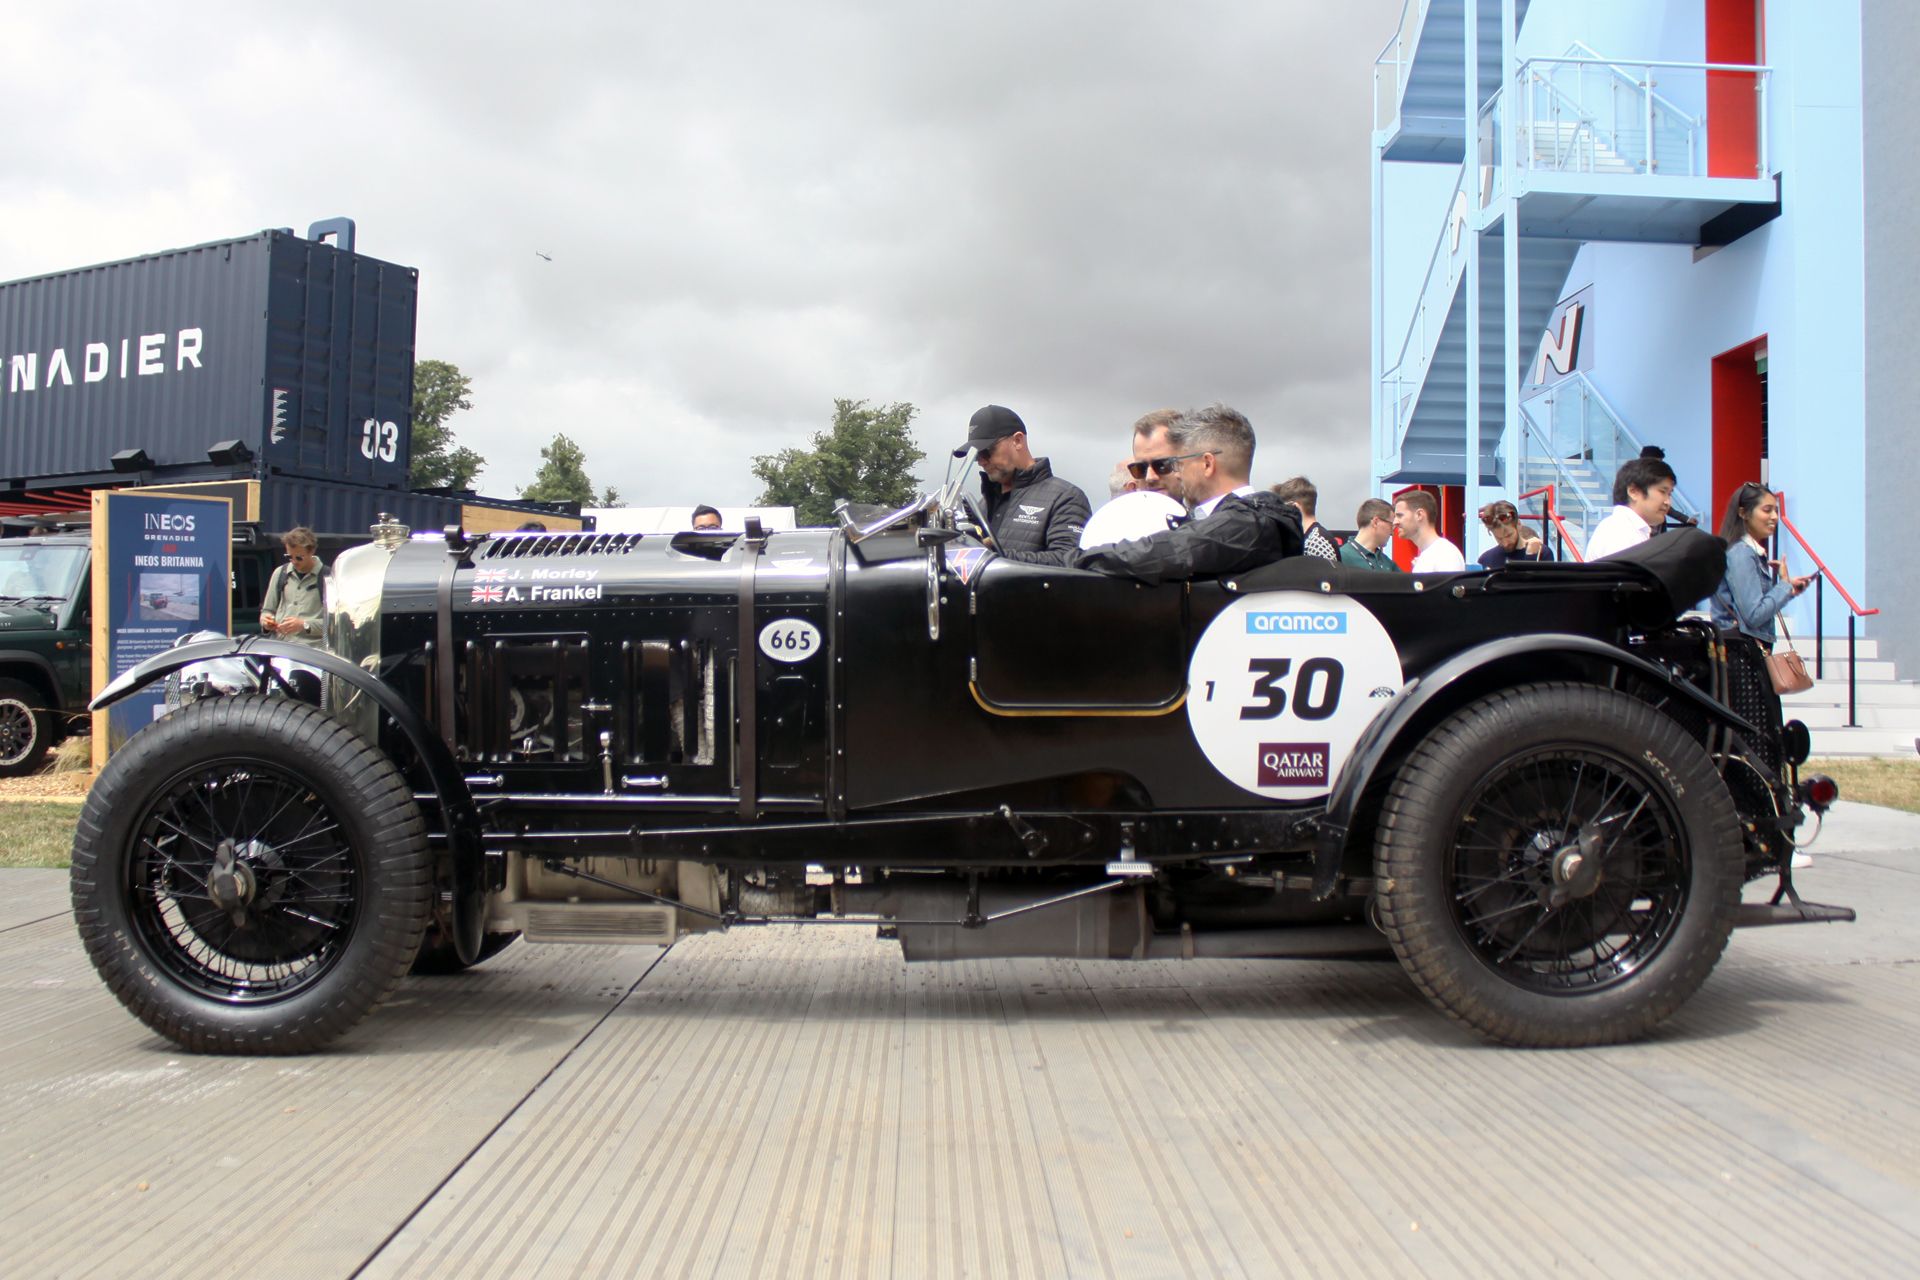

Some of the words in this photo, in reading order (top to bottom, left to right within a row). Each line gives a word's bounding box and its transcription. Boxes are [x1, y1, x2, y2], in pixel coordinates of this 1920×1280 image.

[0, 327, 203, 393] NADIER
[361, 417, 399, 463] 03
[144, 513, 195, 531] INEOS
[144, 534, 195, 542] GRENADIER
[135, 555, 160, 567] INEOS
[161, 556, 204, 568] BRITANNIA
[507, 569, 525, 581] J.
[530, 567, 599, 582] Morley
[505, 586, 525, 602] A.
[531, 584, 602, 601] Frankel
[1254, 615, 1339, 631] aramco
[770, 629, 811, 651] 665
[1205, 681, 1216, 702] 1
[1239, 657, 1345, 721] 30
[1263, 752, 1324, 771] QATAR
[1277, 767, 1324, 778] AIRWAYS
